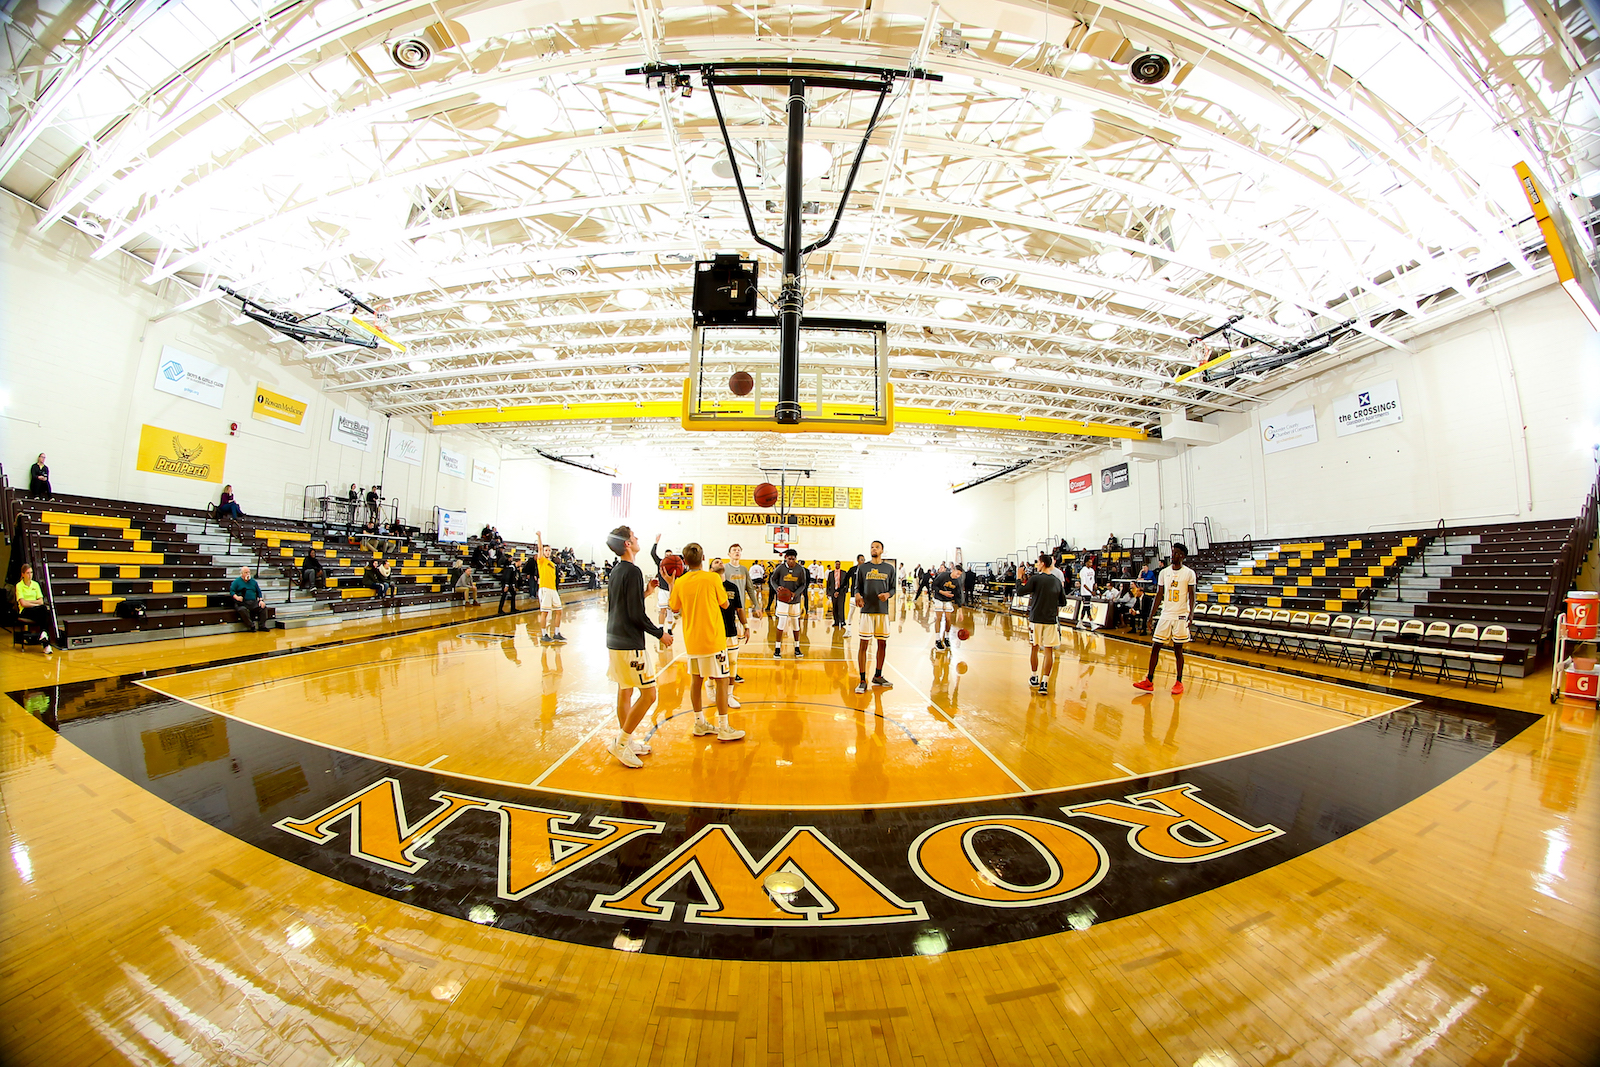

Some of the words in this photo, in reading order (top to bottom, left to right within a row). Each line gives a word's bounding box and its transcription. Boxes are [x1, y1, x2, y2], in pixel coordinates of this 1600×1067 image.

[1339, 414, 1352, 423] the
[1354, 400, 1397, 419] CROSSINGS
[728, 513, 767, 524] ROWAN
[769, 514, 835, 526] UNIERSITY
[1168, 589, 1180, 602] 15
[1575, 605, 1586, 618] G
[1577, 676, 1589, 691] G
[273, 777, 1287, 927] ROWAN
